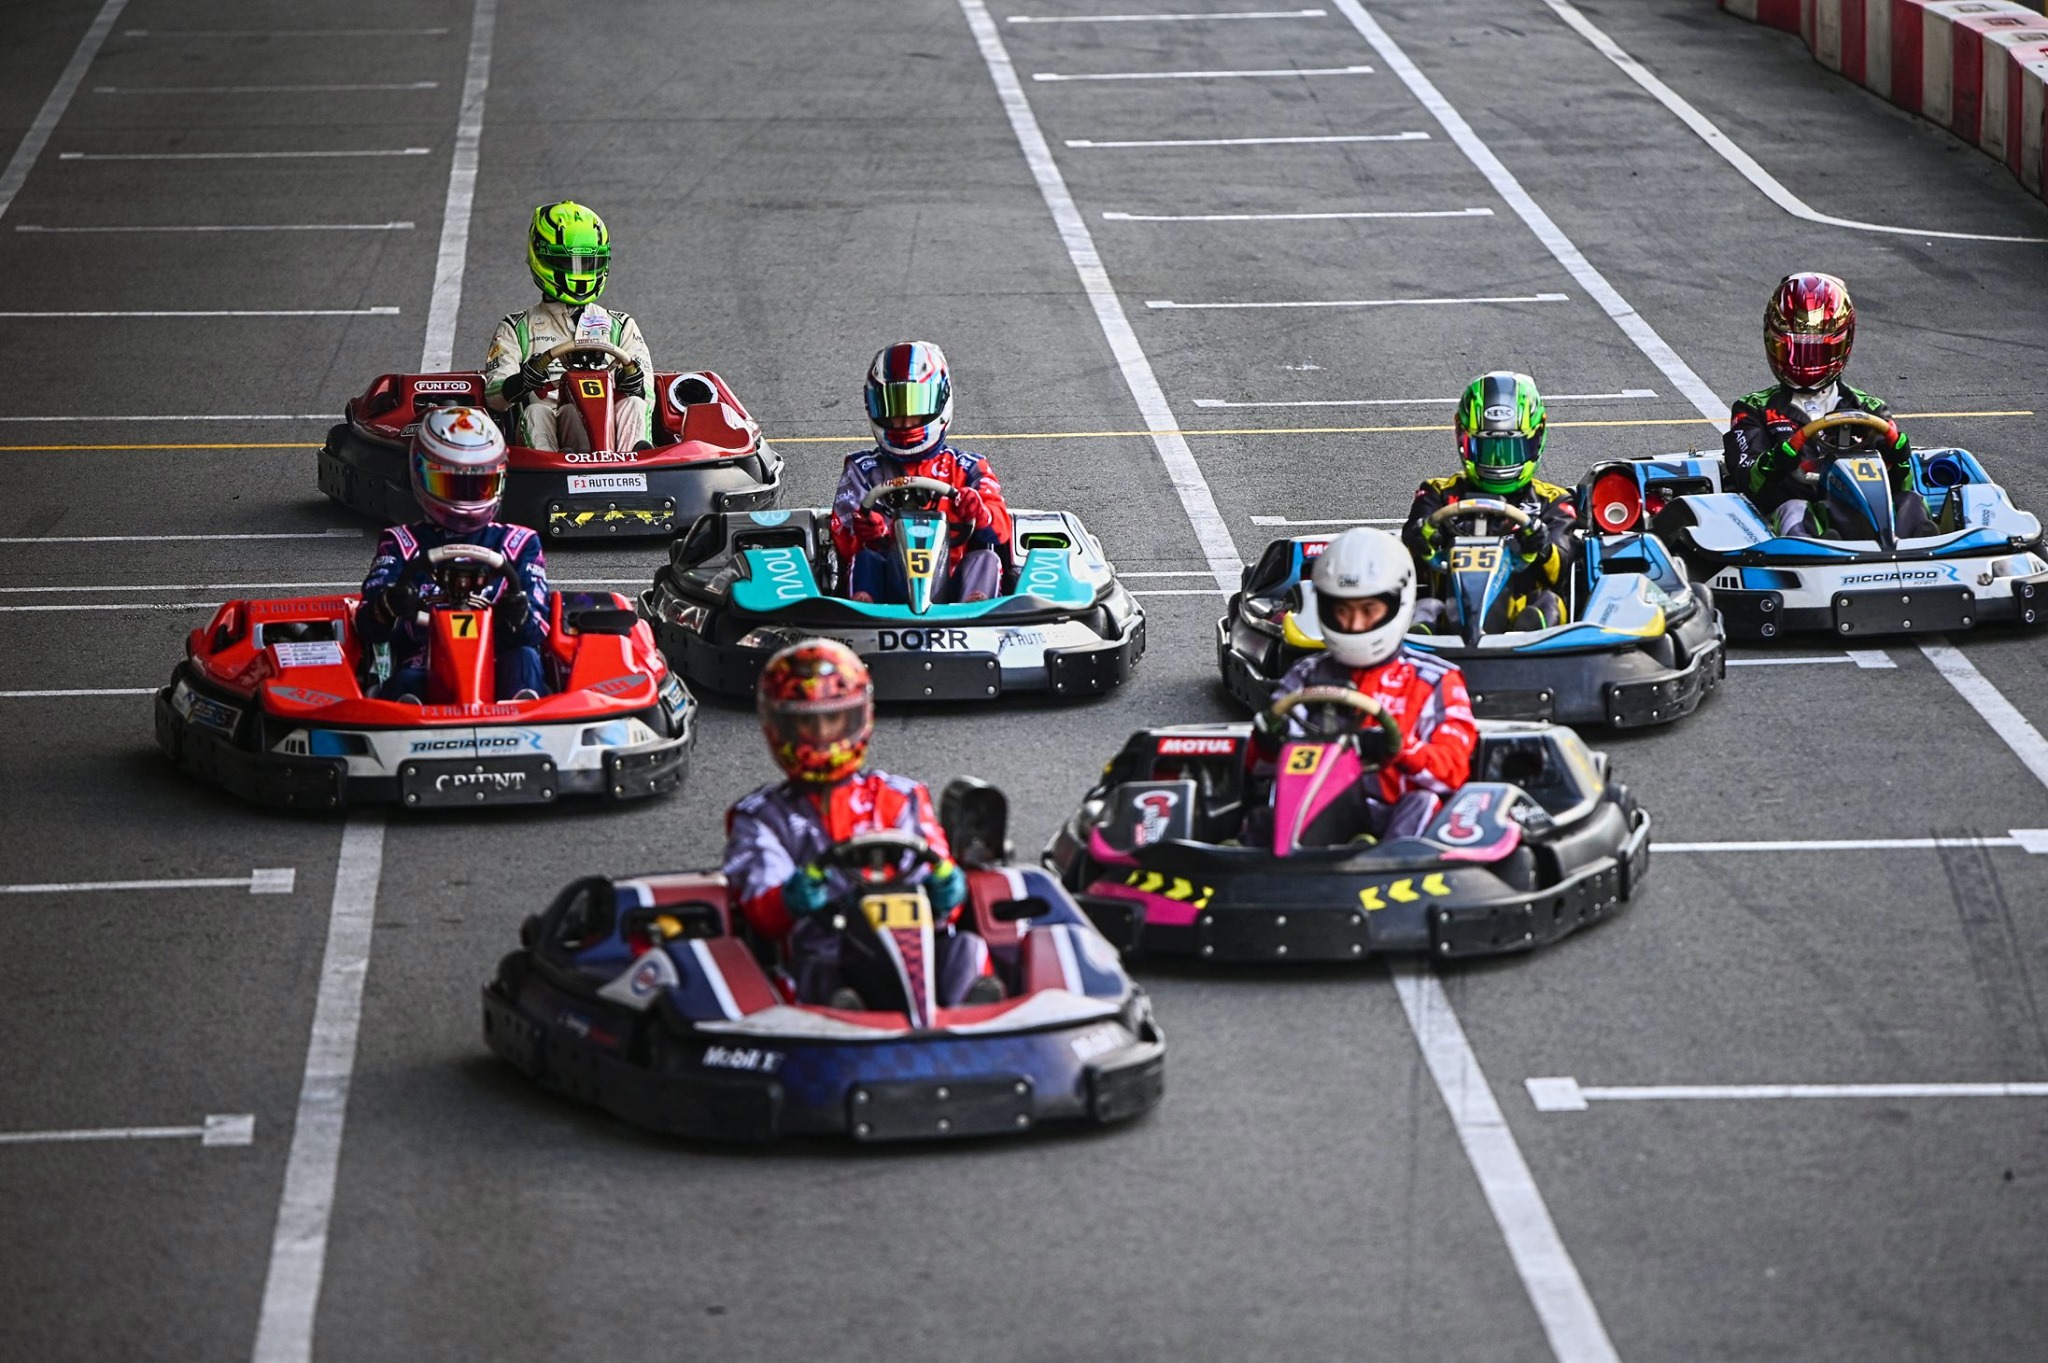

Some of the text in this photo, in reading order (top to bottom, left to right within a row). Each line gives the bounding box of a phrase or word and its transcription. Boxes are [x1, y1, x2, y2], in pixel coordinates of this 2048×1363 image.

[583, 381, 600, 396] 6
[565, 450, 638, 463] ORIENT
[1858, 463, 1876, 478] 4
[574, 477, 641, 488] F1 AUTO CARS
[911, 553, 930, 574] 5
[1453, 551, 1497, 569] 55
[762, 550, 808, 599] novu
[1026, 551, 1063, 598] novu
[1842, 571, 1938, 585] RICCIARDO
[271, 602, 307, 613] AUTO
[311, 601, 345, 611] CARS
[452, 614, 473, 637] 7
[878, 630, 969, 650] DORR
[421, 704, 519, 716] F1 AUTO CARS
[410, 738, 519, 753] RICCIARDO
[1161, 739, 1233, 753] MOTUL
[1292, 749, 1316, 769] 3
[876, 901, 919, 922] 11
